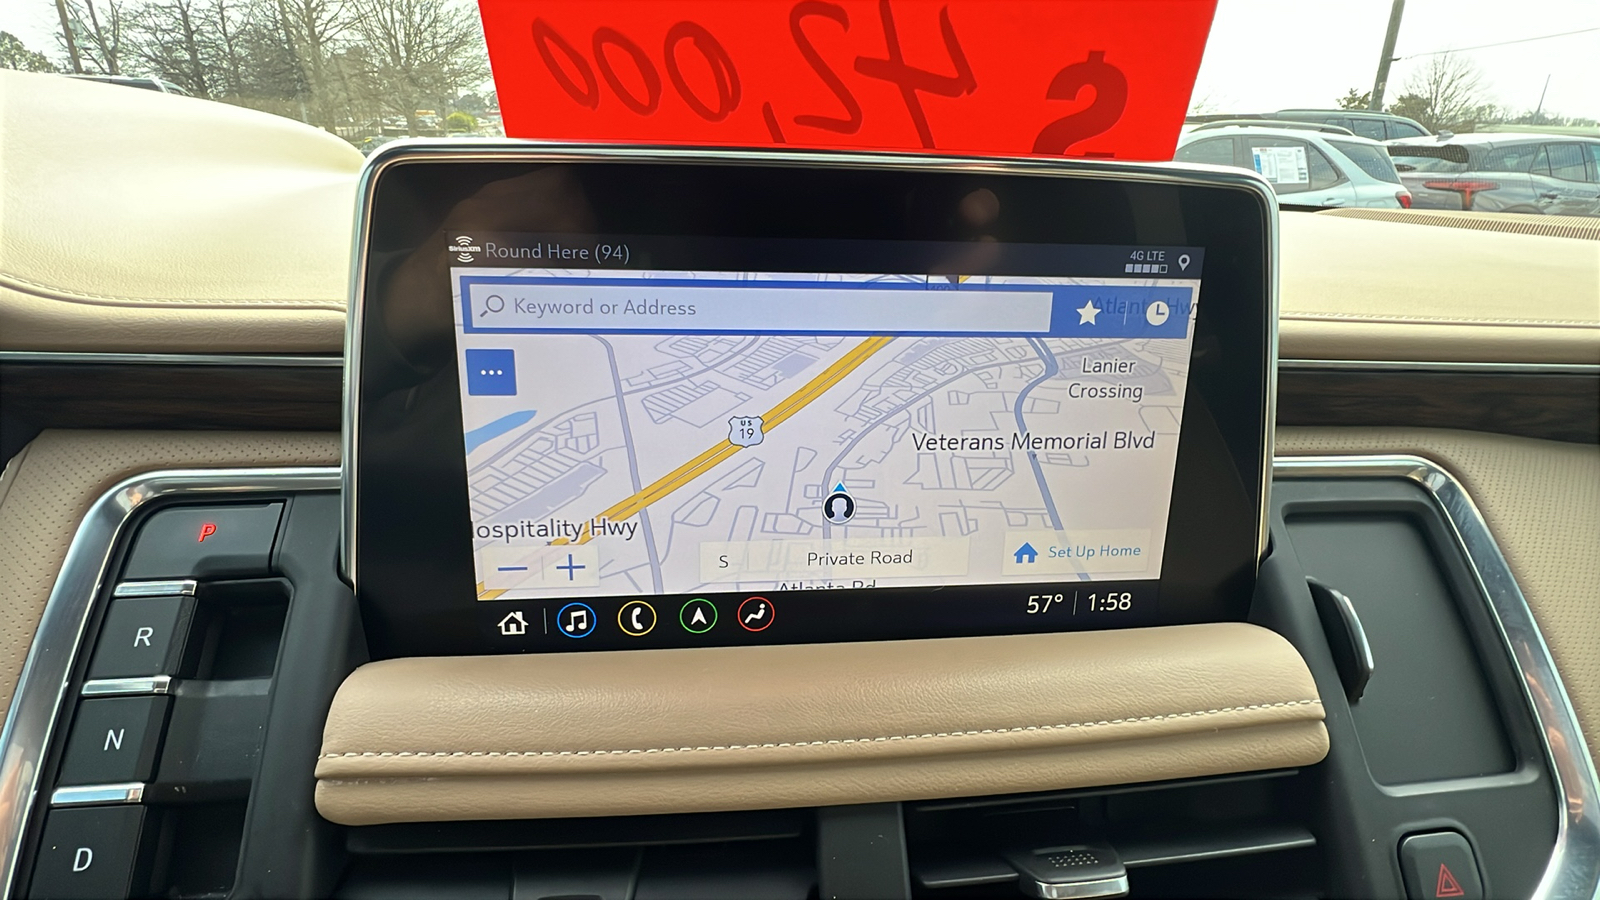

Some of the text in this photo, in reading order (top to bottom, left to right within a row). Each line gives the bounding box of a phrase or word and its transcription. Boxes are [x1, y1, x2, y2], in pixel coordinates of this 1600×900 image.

[485, 242, 631, 264] Round Here (94)
[1130, 250, 1166, 261] 4G LTE
[513, 298, 697, 319] Keyword or Address
[1094, 295, 1150, 315] Atlant
[1081, 357, 1136, 374] Lanier
[1068, 383, 1143, 402] Crossing
[739, 428, 755, 439] 19
[911, 430, 1156, 451] Veterans Memorial Blvd
[198, 523, 217, 542] P
[472, 518, 638, 543] ospitality Hwy
[718, 554, 729, 569] S
[807, 549, 913, 566] Private Road
[1048, 544, 1142, 561] Set Up Home
[1026, 593, 1064, 615] 57°
[1088, 592, 1133, 612] 1:58
[133, 626, 154, 648] R
[103, 728, 125, 751] N
[72, 847, 94, 873] D
